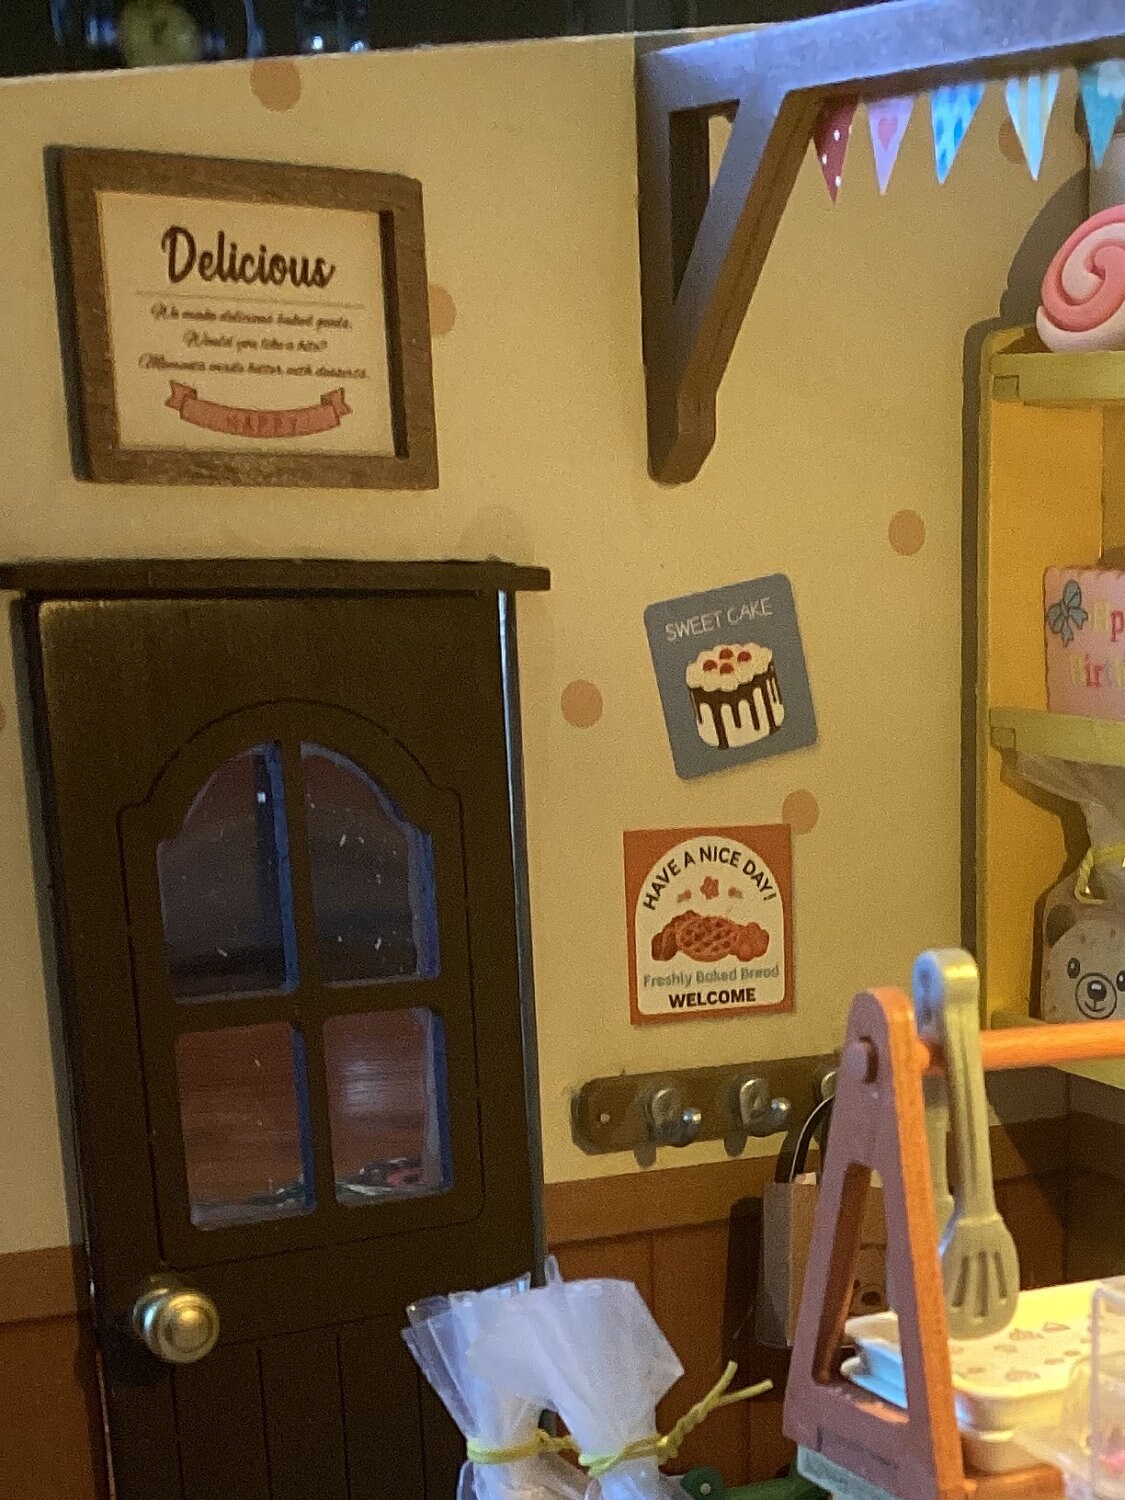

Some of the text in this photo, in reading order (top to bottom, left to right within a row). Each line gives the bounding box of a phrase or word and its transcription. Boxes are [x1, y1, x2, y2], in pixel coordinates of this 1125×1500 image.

[161, 226, 336, 288] Delicious
[664, 596, 774, 642] SWEET CAKE
[642, 845, 778, 911] HAVE A NICE DAY!
[643, 970, 693, 988] Freshly
[668, 987, 757, 1010] WELCOME
